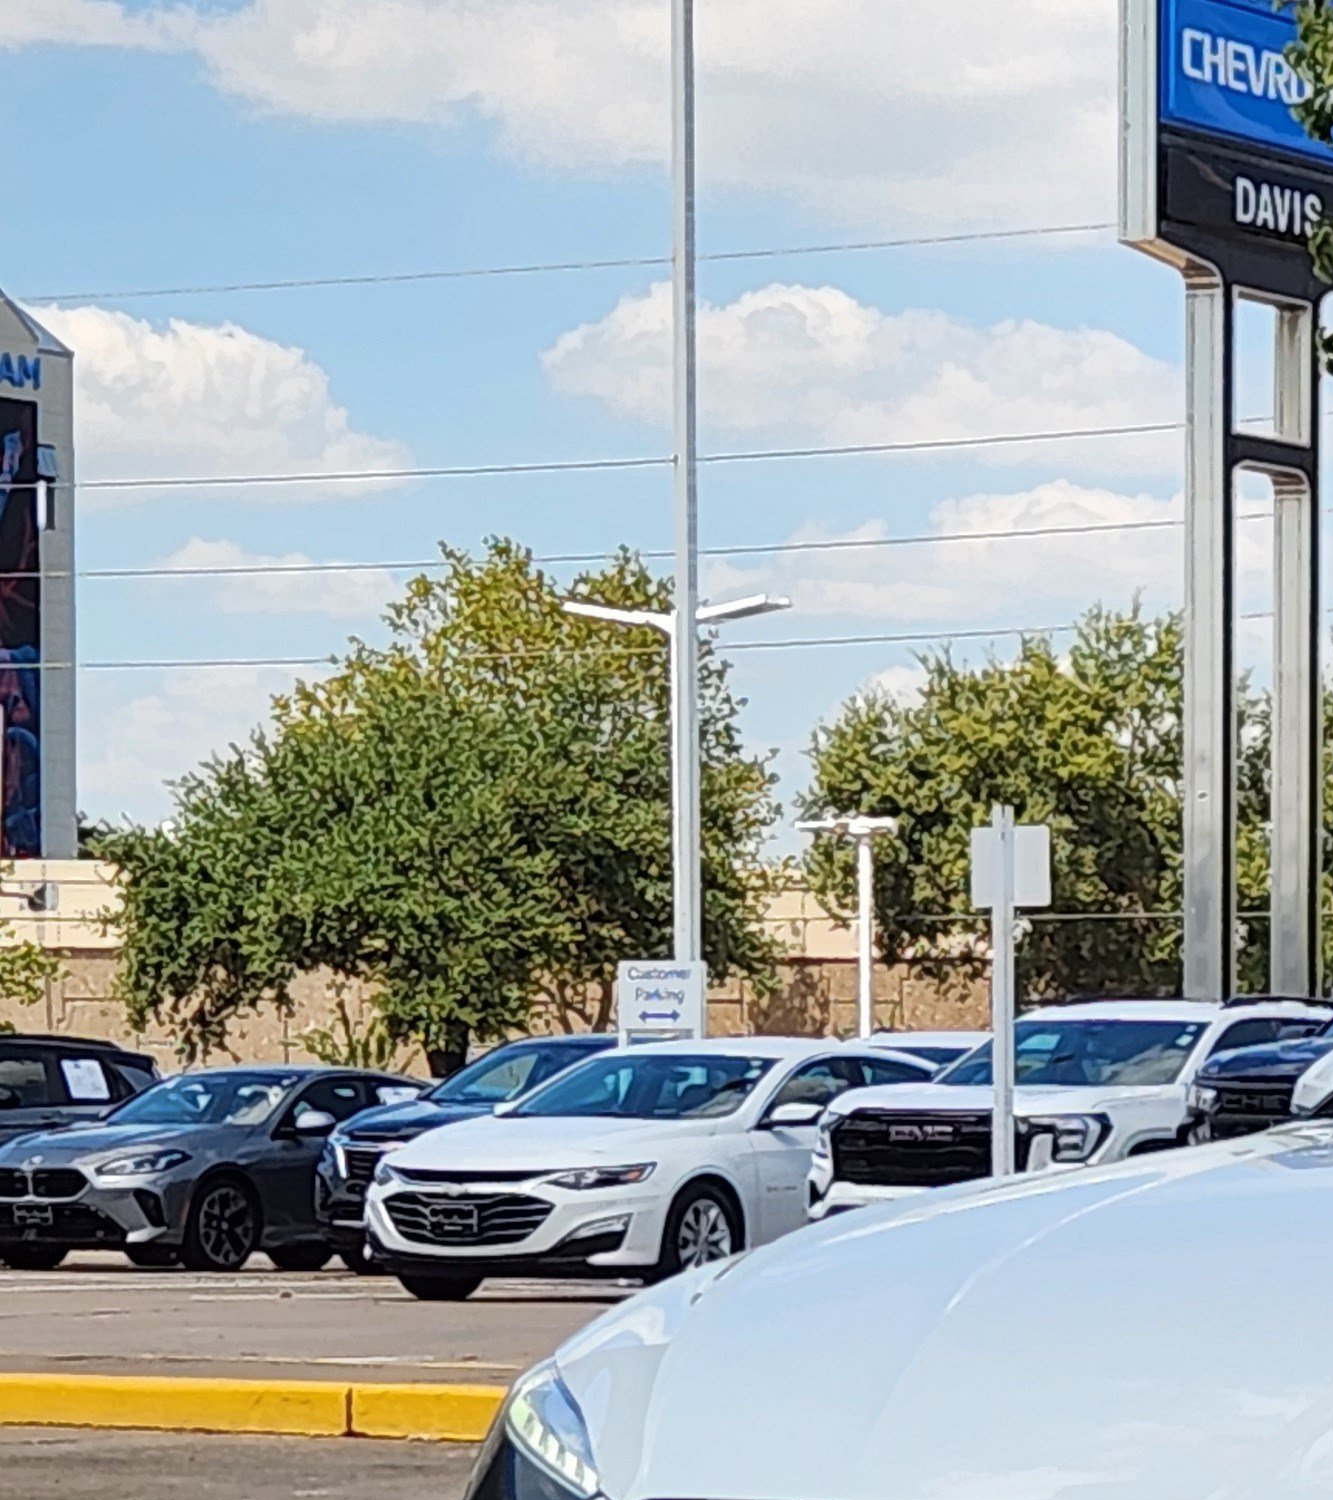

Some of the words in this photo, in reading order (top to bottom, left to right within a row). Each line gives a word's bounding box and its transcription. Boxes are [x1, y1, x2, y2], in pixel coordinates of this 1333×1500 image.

[1235, 175, 1323, 239] DAVIS
[627, 966, 692, 980] Customer
[635, 986, 685, 1005] Parking
